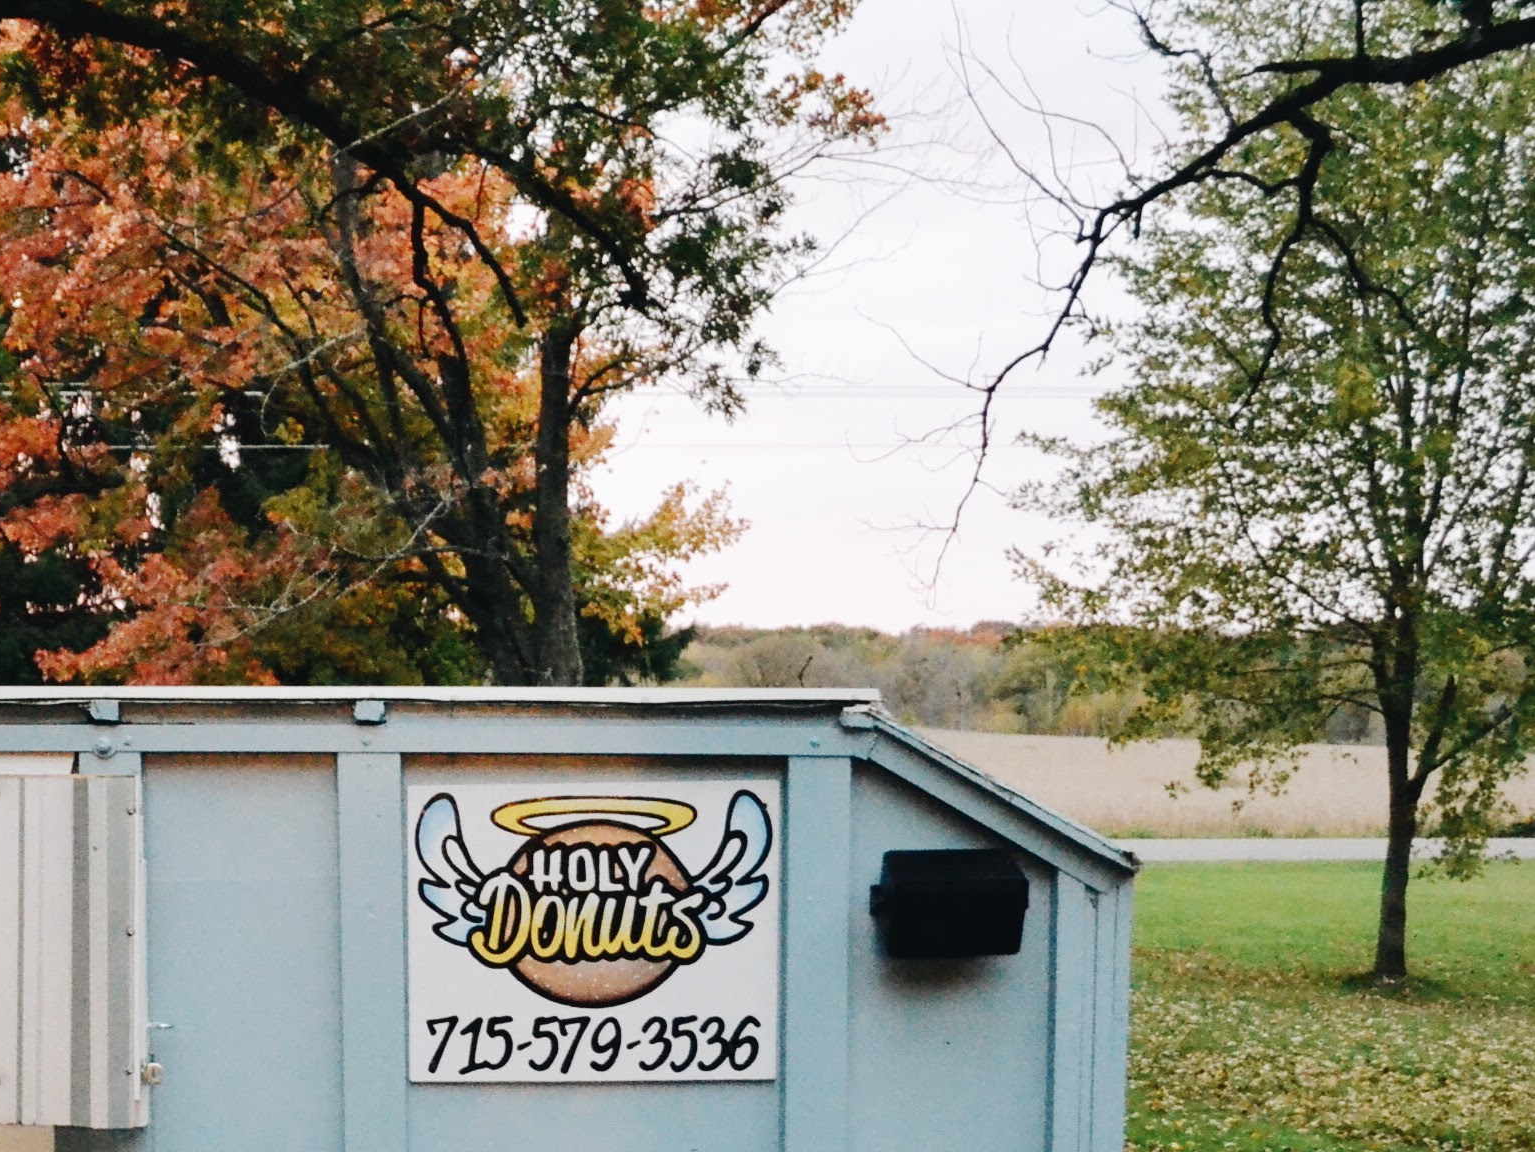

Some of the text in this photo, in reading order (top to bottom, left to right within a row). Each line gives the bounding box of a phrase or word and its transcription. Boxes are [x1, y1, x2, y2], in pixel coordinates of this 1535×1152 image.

[529, 846, 652, 893] HOLY
[470, 872, 704, 964] Donuts
[425, 1014, 761, 1075] 715-579-3536
